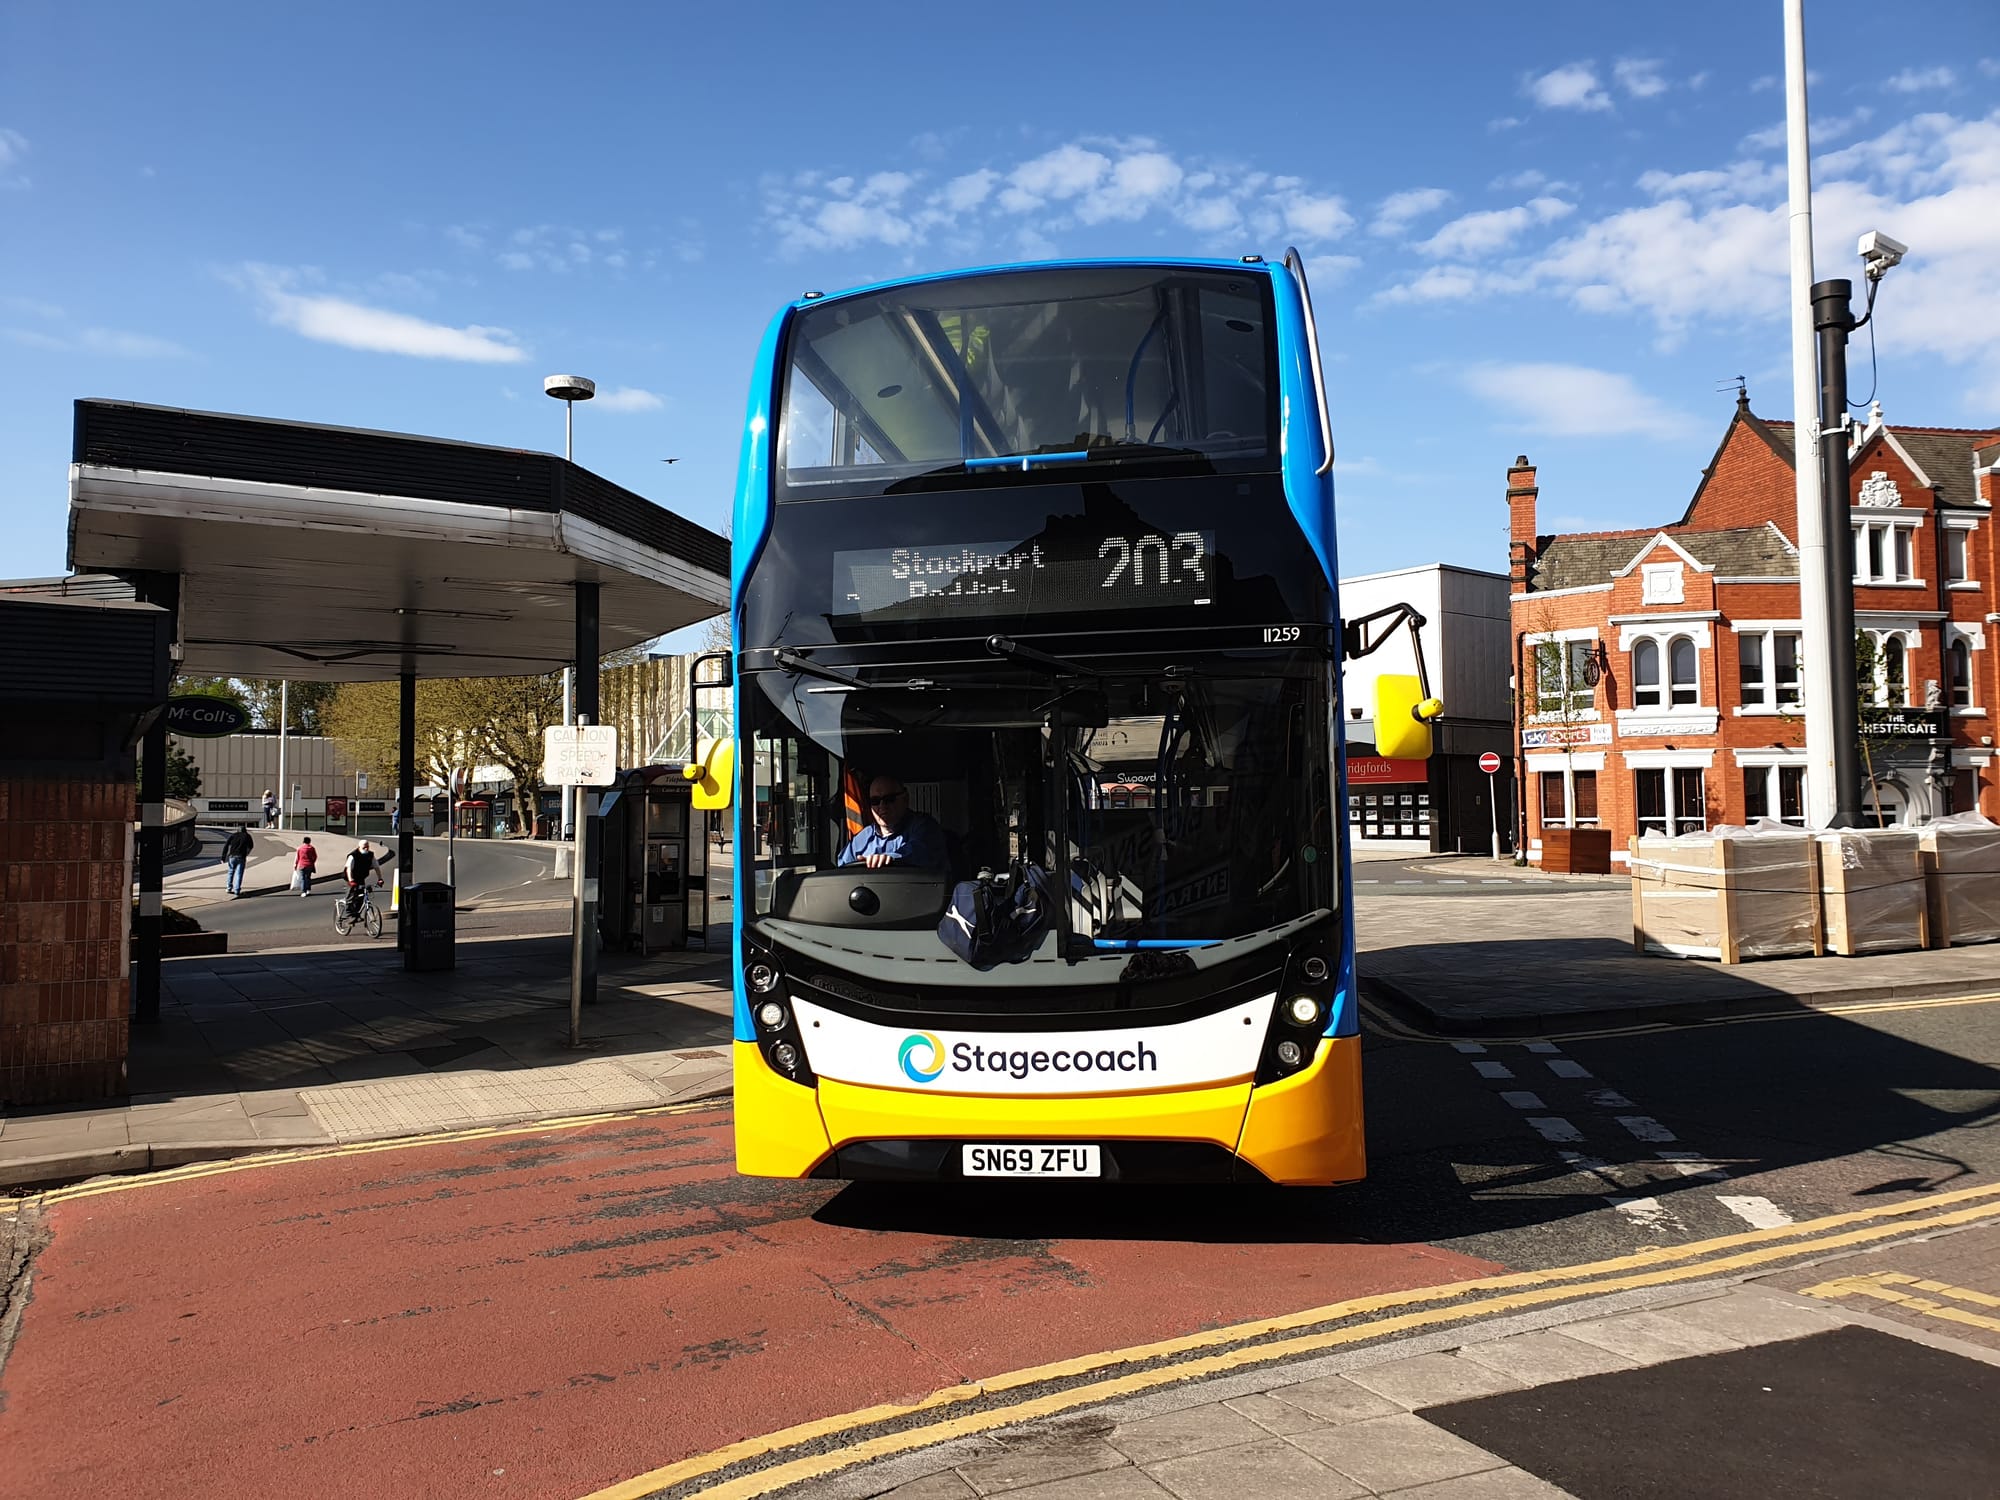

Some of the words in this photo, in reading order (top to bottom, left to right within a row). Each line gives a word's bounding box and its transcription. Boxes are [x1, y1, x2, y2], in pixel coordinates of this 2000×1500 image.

[892, 545, 1045, 579] Stockport
[1263, 626, 1301, 643] 11259
[167, 706, 237, 724] McColl's
[1888, 714, 1905, 722] THE
[553, 729, 609, 741] CAUTION
[560, 750, 602, 761] SPEED
[557, 766, 601, 778] RAMS
[952, 1041, 1157, 1080] Stagecoach
[972, 1149, 1033, 1171] SN69
[1040, 1149, 1087, 1172] ZFU
